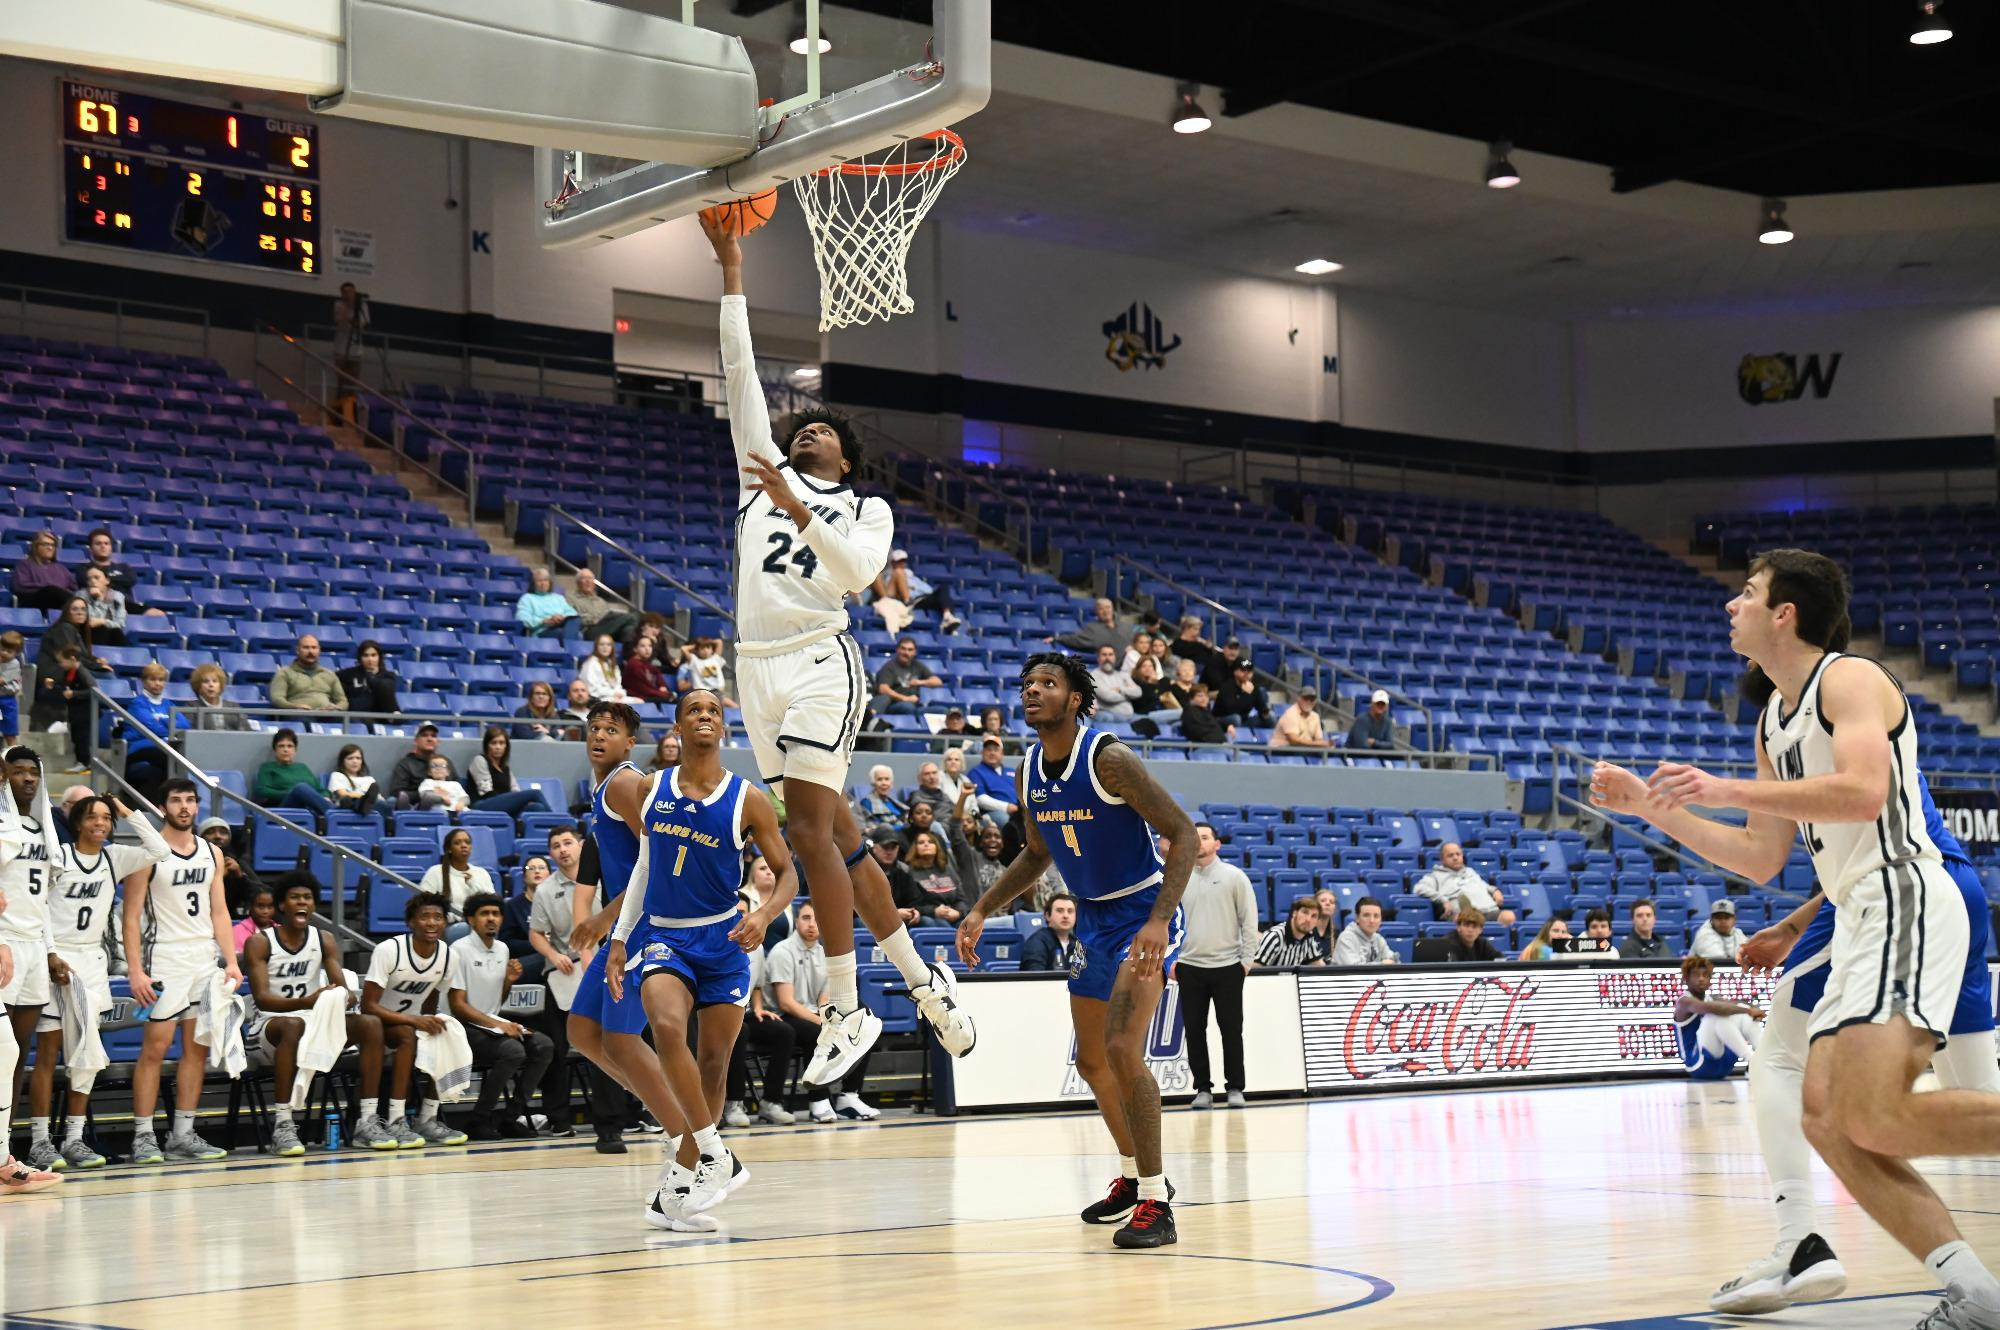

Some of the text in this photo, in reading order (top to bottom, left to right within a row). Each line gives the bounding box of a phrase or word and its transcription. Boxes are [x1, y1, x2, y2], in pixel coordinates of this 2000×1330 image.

[71, 84, 119, 103] HOME
[80, 100, 117, 135] 67
[266, 119, 313, 137] GUEST
[227, 116, 238, 148] 1
[291, 136, 310, 168] 2
[187, 172, 202, 195] 2
[472, 229, 491, 255] K
[946, 300, 959, 321] L
[1323, 355, 1337, 374] M
[762, 531, 818, 580] 24
[1031, 788, 1047, 799] SAC
[657, 800, 676, 811] SAC
[1036, 808, 1094, 822] MARS HILL
[652, 821, 720, 849] MARS HILL
[1061, 824, 1082, 857] 4
[16, 843, 49, 861] LMU
[672, 844, 688, 877] 1
[29, 868, 42, 895] 5
[172, 868, 208, 886] LMU
[64, 880, 105, 899] LMU
[186, 891, 199, 916] 3
[77, 906, 92, 931] 0
[276, 960, 310, 978] LMU
[392, 980, 433, 996] LMU
[509, 990, 540, 1008] LMU
